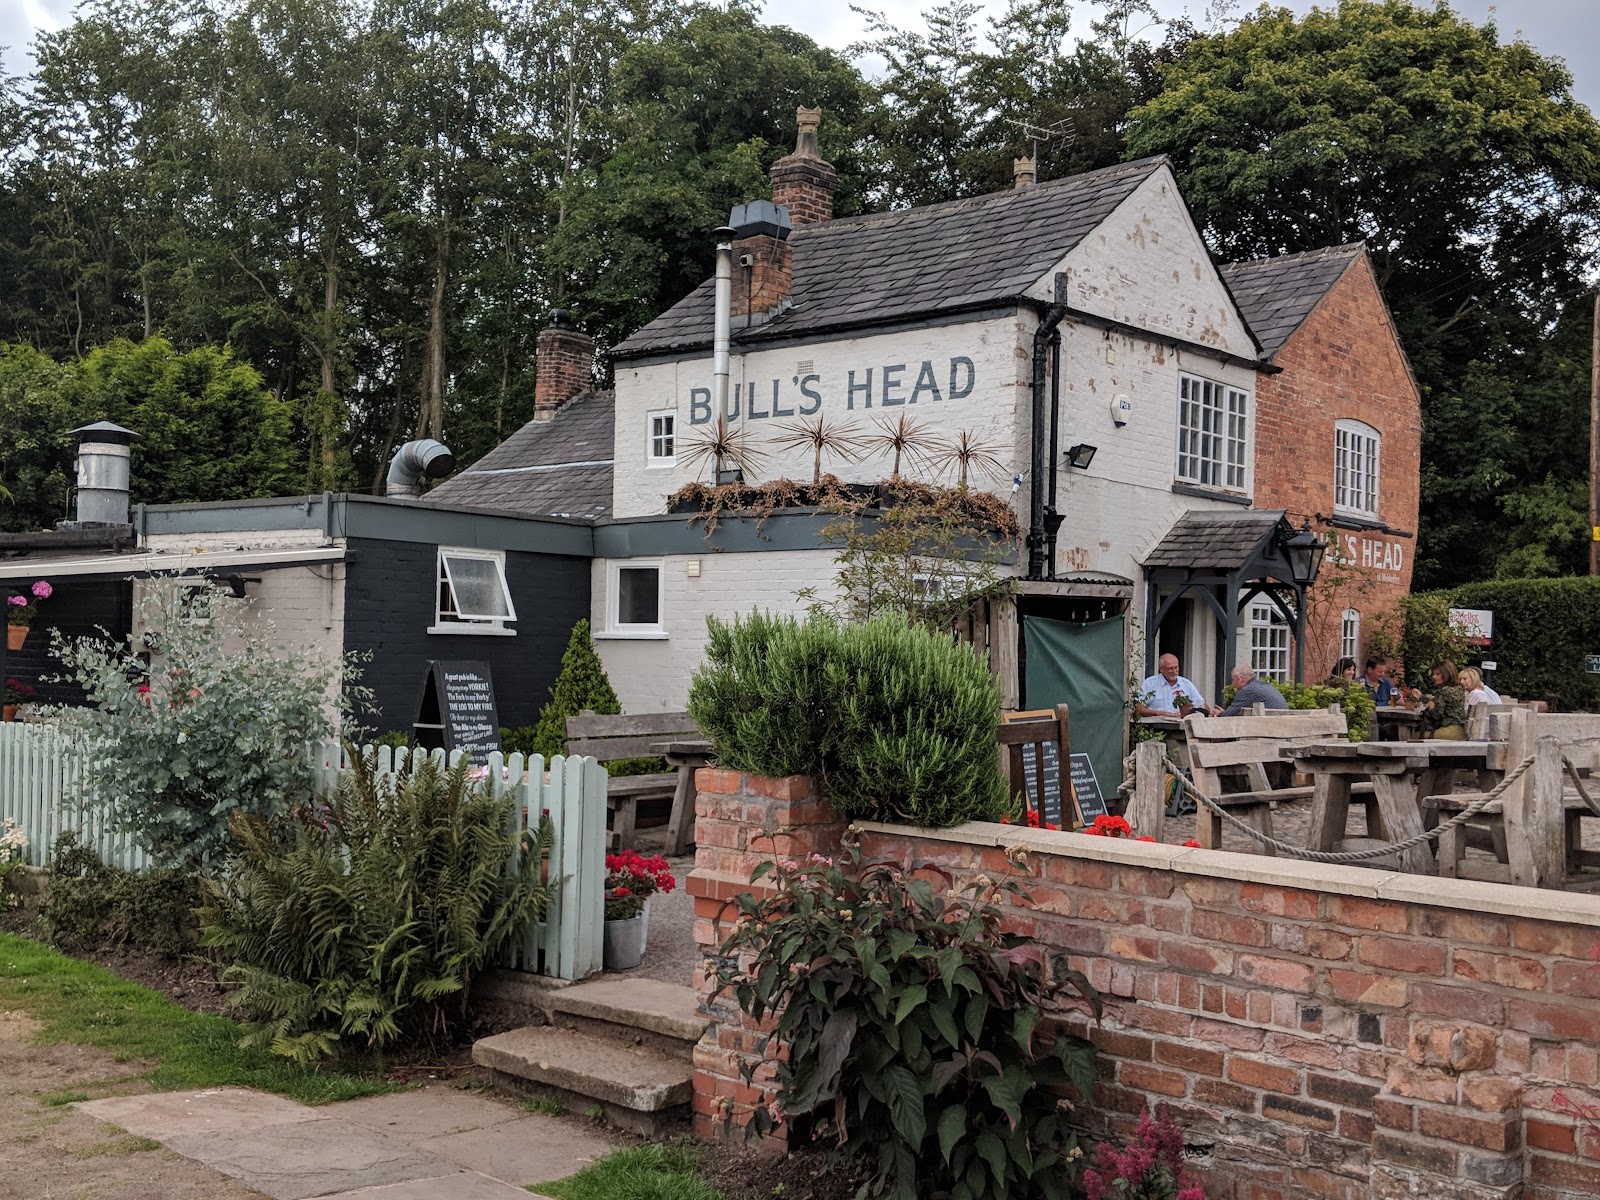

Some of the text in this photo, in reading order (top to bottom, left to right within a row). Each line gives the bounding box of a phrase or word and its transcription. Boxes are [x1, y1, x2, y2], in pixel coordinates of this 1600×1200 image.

[690, 356, 976, 425] BULL'S HEAD
[1361, 538, 1403, 571] HEAD
[468, 682, 490, 691] YORKIE!
[449, 702, 494, 711] THE LOG TO MY FIRE
[452, 723, 461, 731] The
[486, 742, 498, 751] FISH
